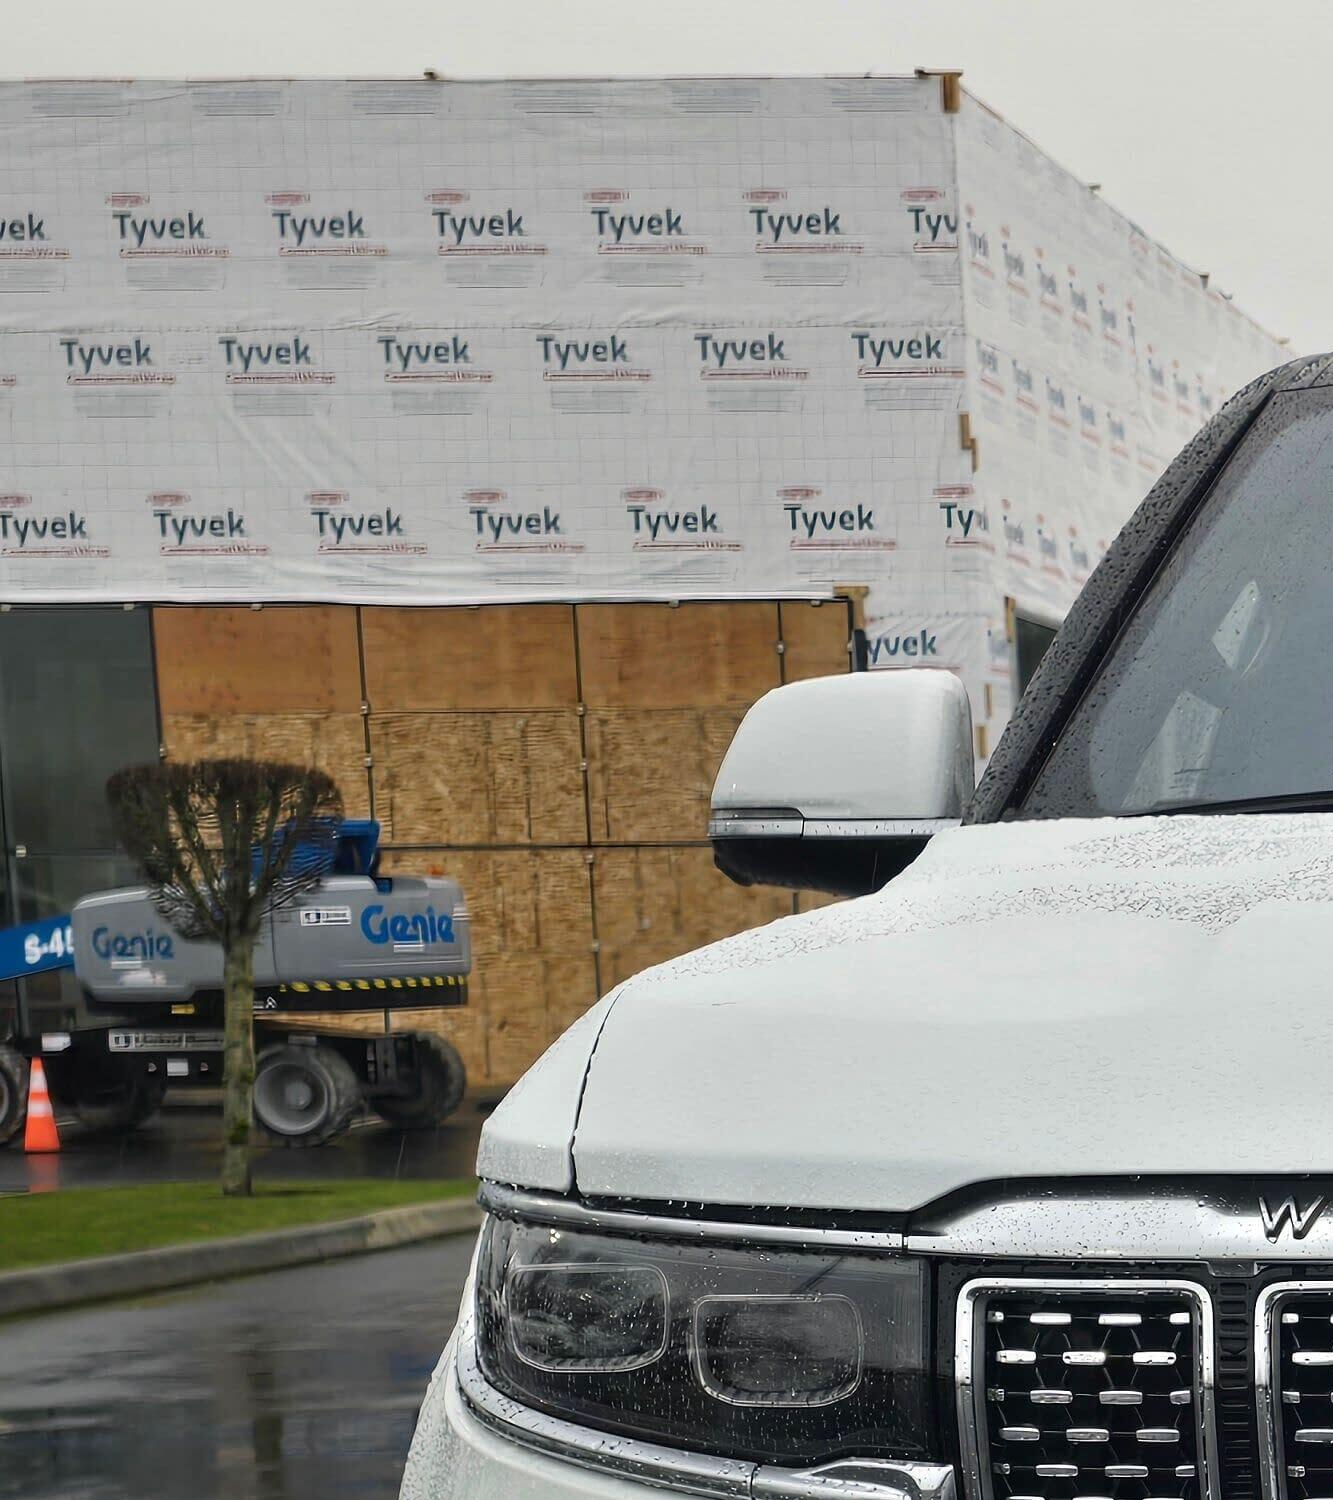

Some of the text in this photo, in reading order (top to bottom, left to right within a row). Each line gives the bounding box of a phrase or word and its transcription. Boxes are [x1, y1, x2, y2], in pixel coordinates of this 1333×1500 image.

[112, 210, 206, 247] Tyvek
[272, 209, 365, 247] Tyvek
[432, 208, 524, 246] Tyvek
[591, 207, 684, 245] Tyvek
[749, 206, 841, 243] Tyvek
[907, 206, 957, 242] Tyv
[60, 338, 152, 371] Tyvek
[218, 336, 311, 371] Tyvek
[377, 336, 469, 371] Tyvek
[536, 334, 628, 370] Tyvek
[694, 332, 786, 368] Tyvek
[851, 332, 942, 367] Tyvek
[0, 510, 87, 547] Tyvek
[153, 508, 245, 545] Tyvek
[311, 507, 403, 544] Tyvek
[469, 506, 561, 543] Tyvek
[627, 504, 718, 541] Tyvek
[784, 503, 874, 540] Tyvek
[866, 629, 937, 664] yvek
[92, 925, 173, 960] Genie
[361, 905, 455, 945] Genie
